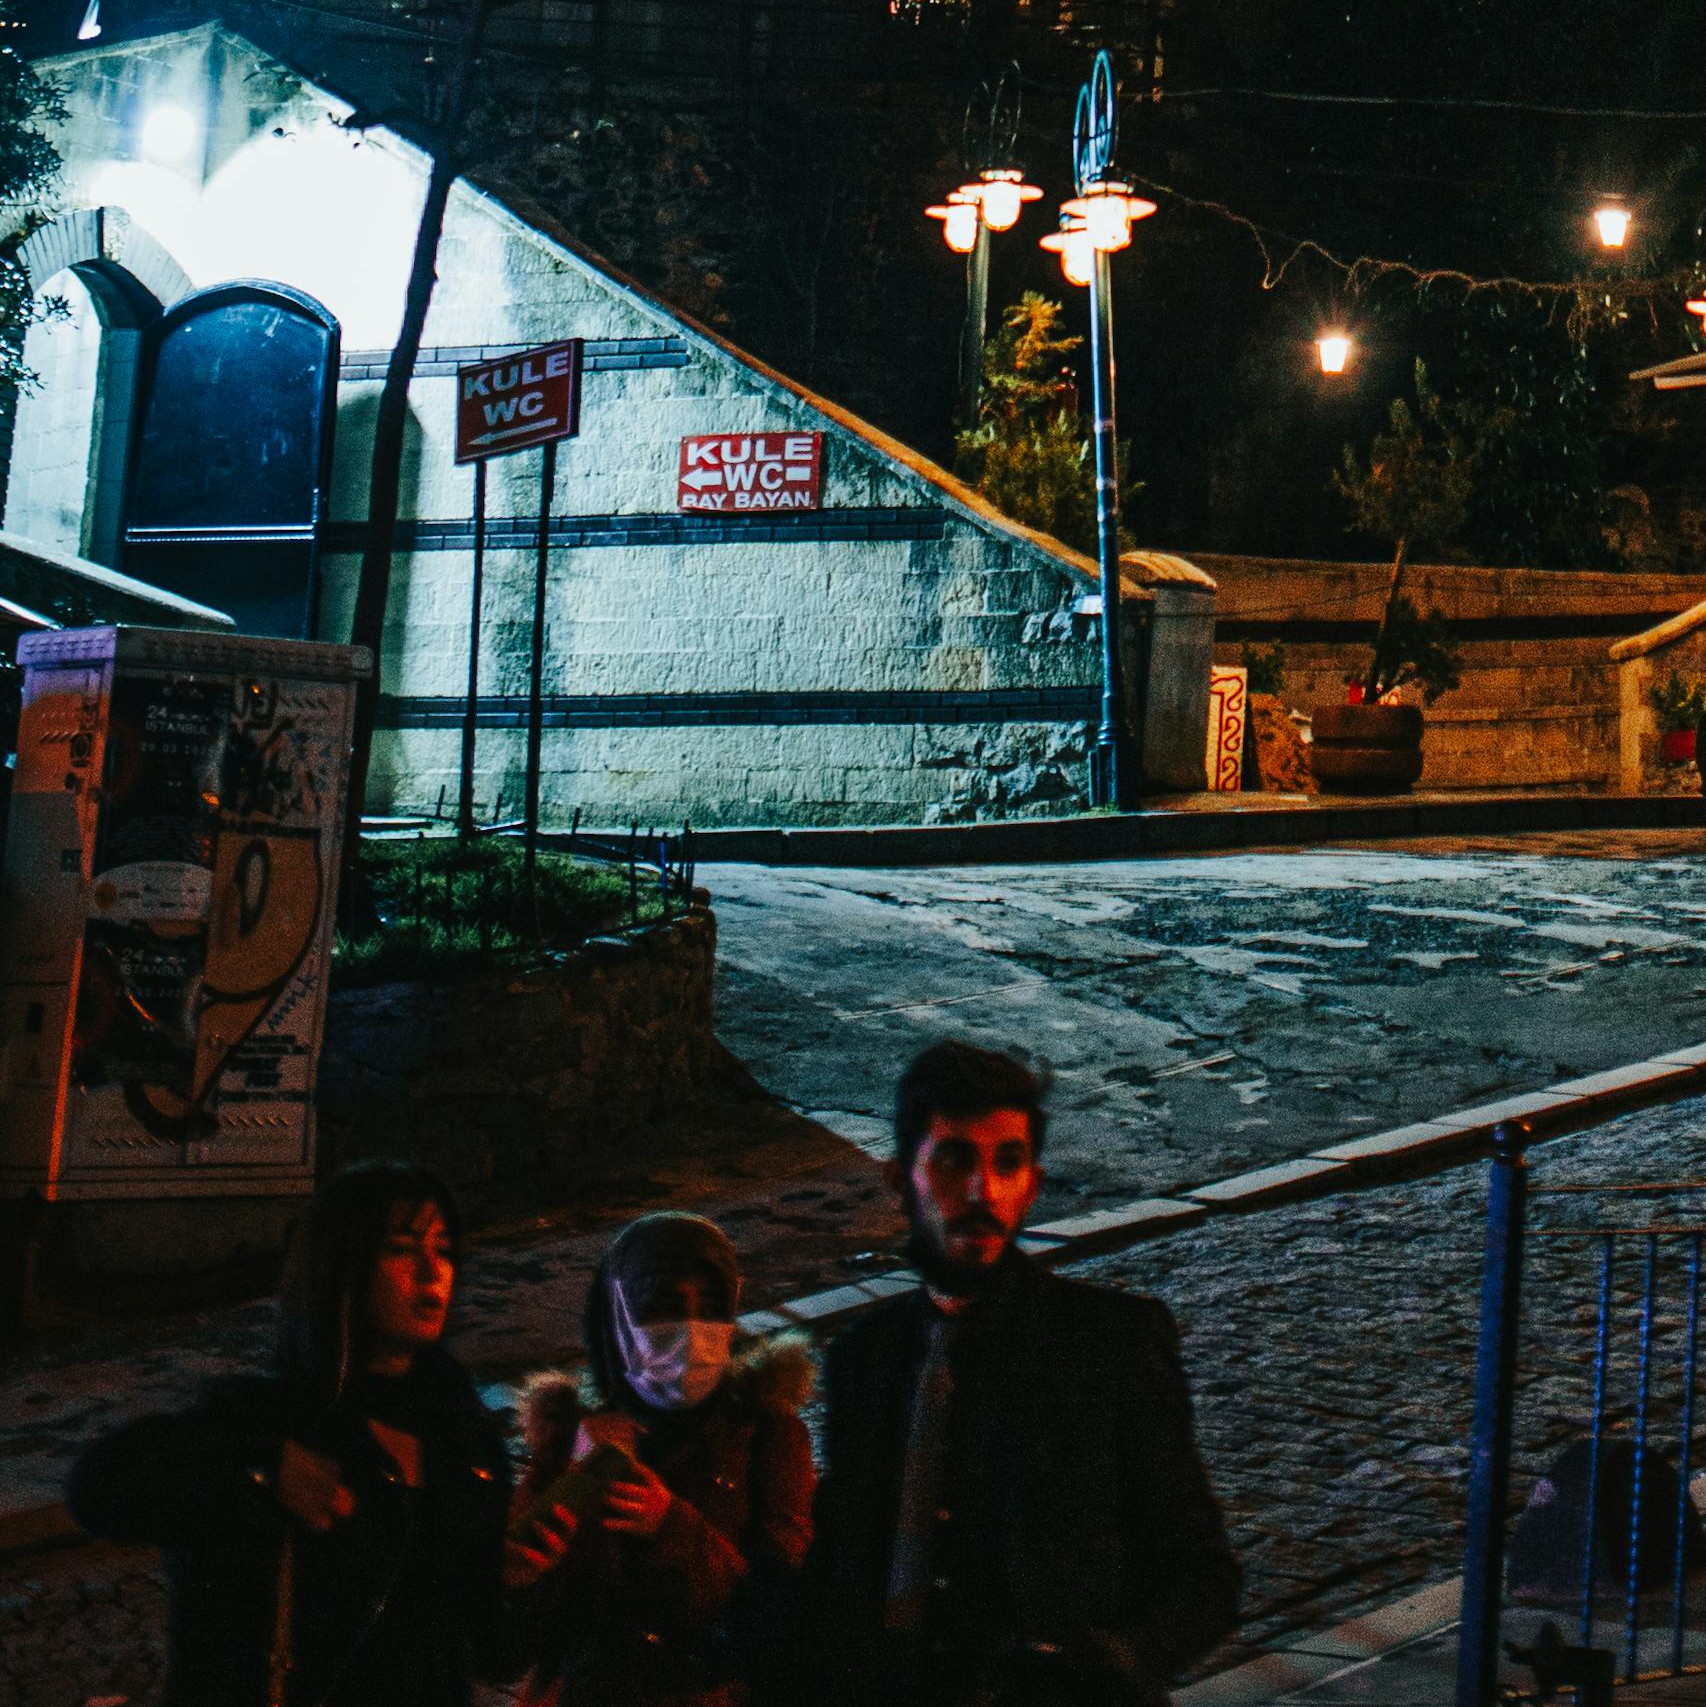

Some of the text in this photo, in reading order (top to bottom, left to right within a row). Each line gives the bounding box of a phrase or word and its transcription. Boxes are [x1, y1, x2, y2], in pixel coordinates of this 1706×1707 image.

[464, 351, 568, 400] KULE
[483, 391, 544, 426] WC
[687, 437, 814, 466] KULE
[723, 461, 784, 491] WC
[735, 491, 810, 508] BAYAN
